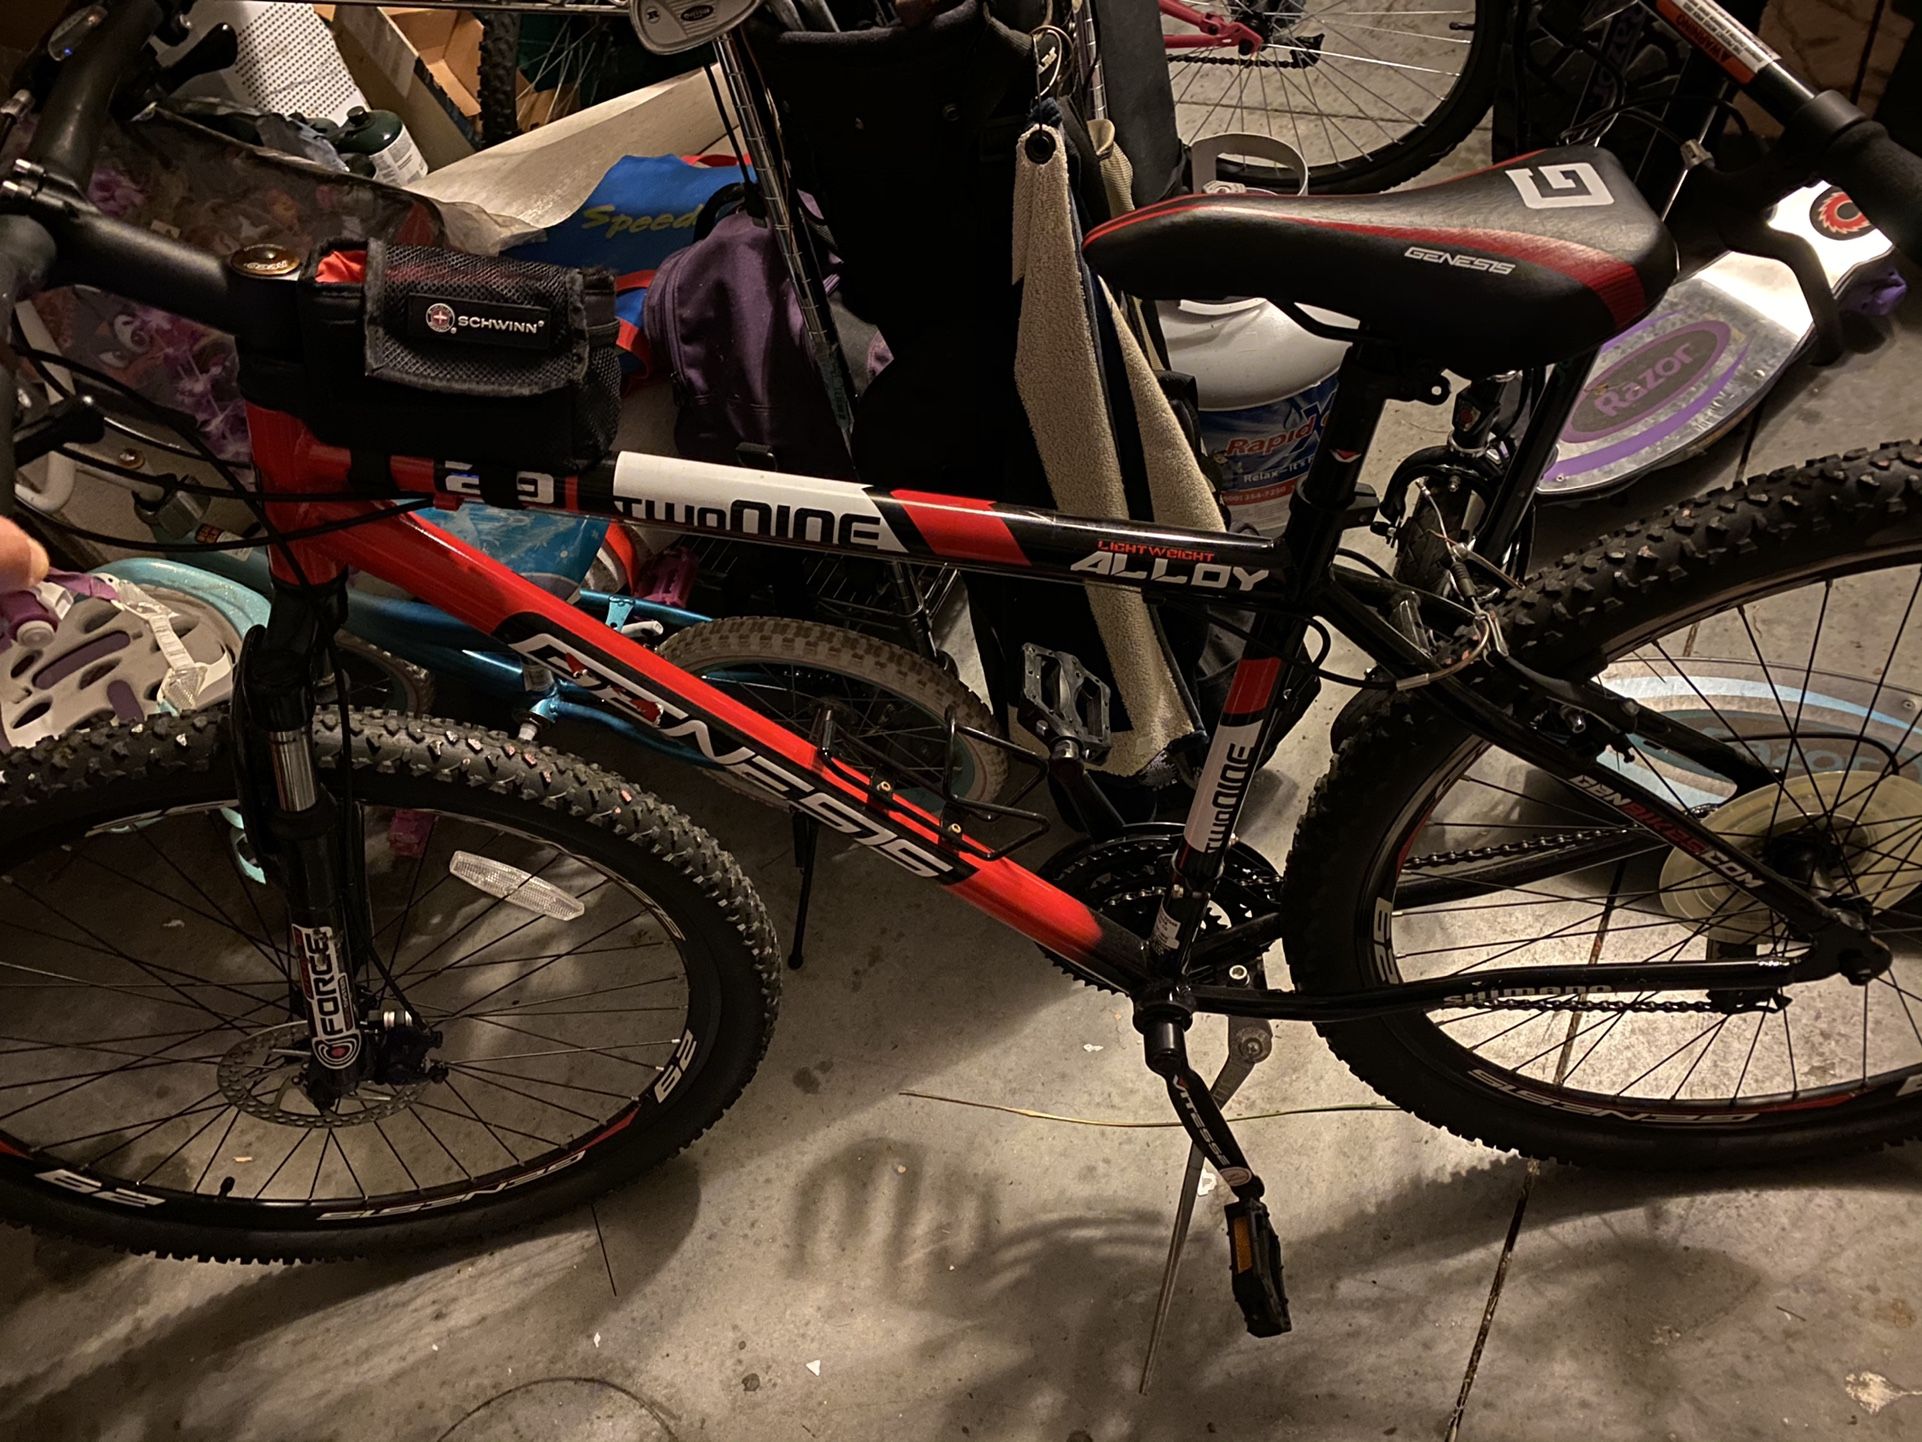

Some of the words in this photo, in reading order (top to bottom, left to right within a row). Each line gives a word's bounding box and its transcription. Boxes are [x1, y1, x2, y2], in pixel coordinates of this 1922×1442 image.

[1404, 246, 1516, 275] GENESIS
[458, 315, 538, 334] SCHWINN
[1594, 343, 1695, 418] Razor
[1225, 413, 1317, 457] Rapid
[1070, 550, 1270, 592] ALLOY
[1098, 539, 1216, 563] LIGHTWEIGHT
[304, 931, 345, 1037] FORCE
